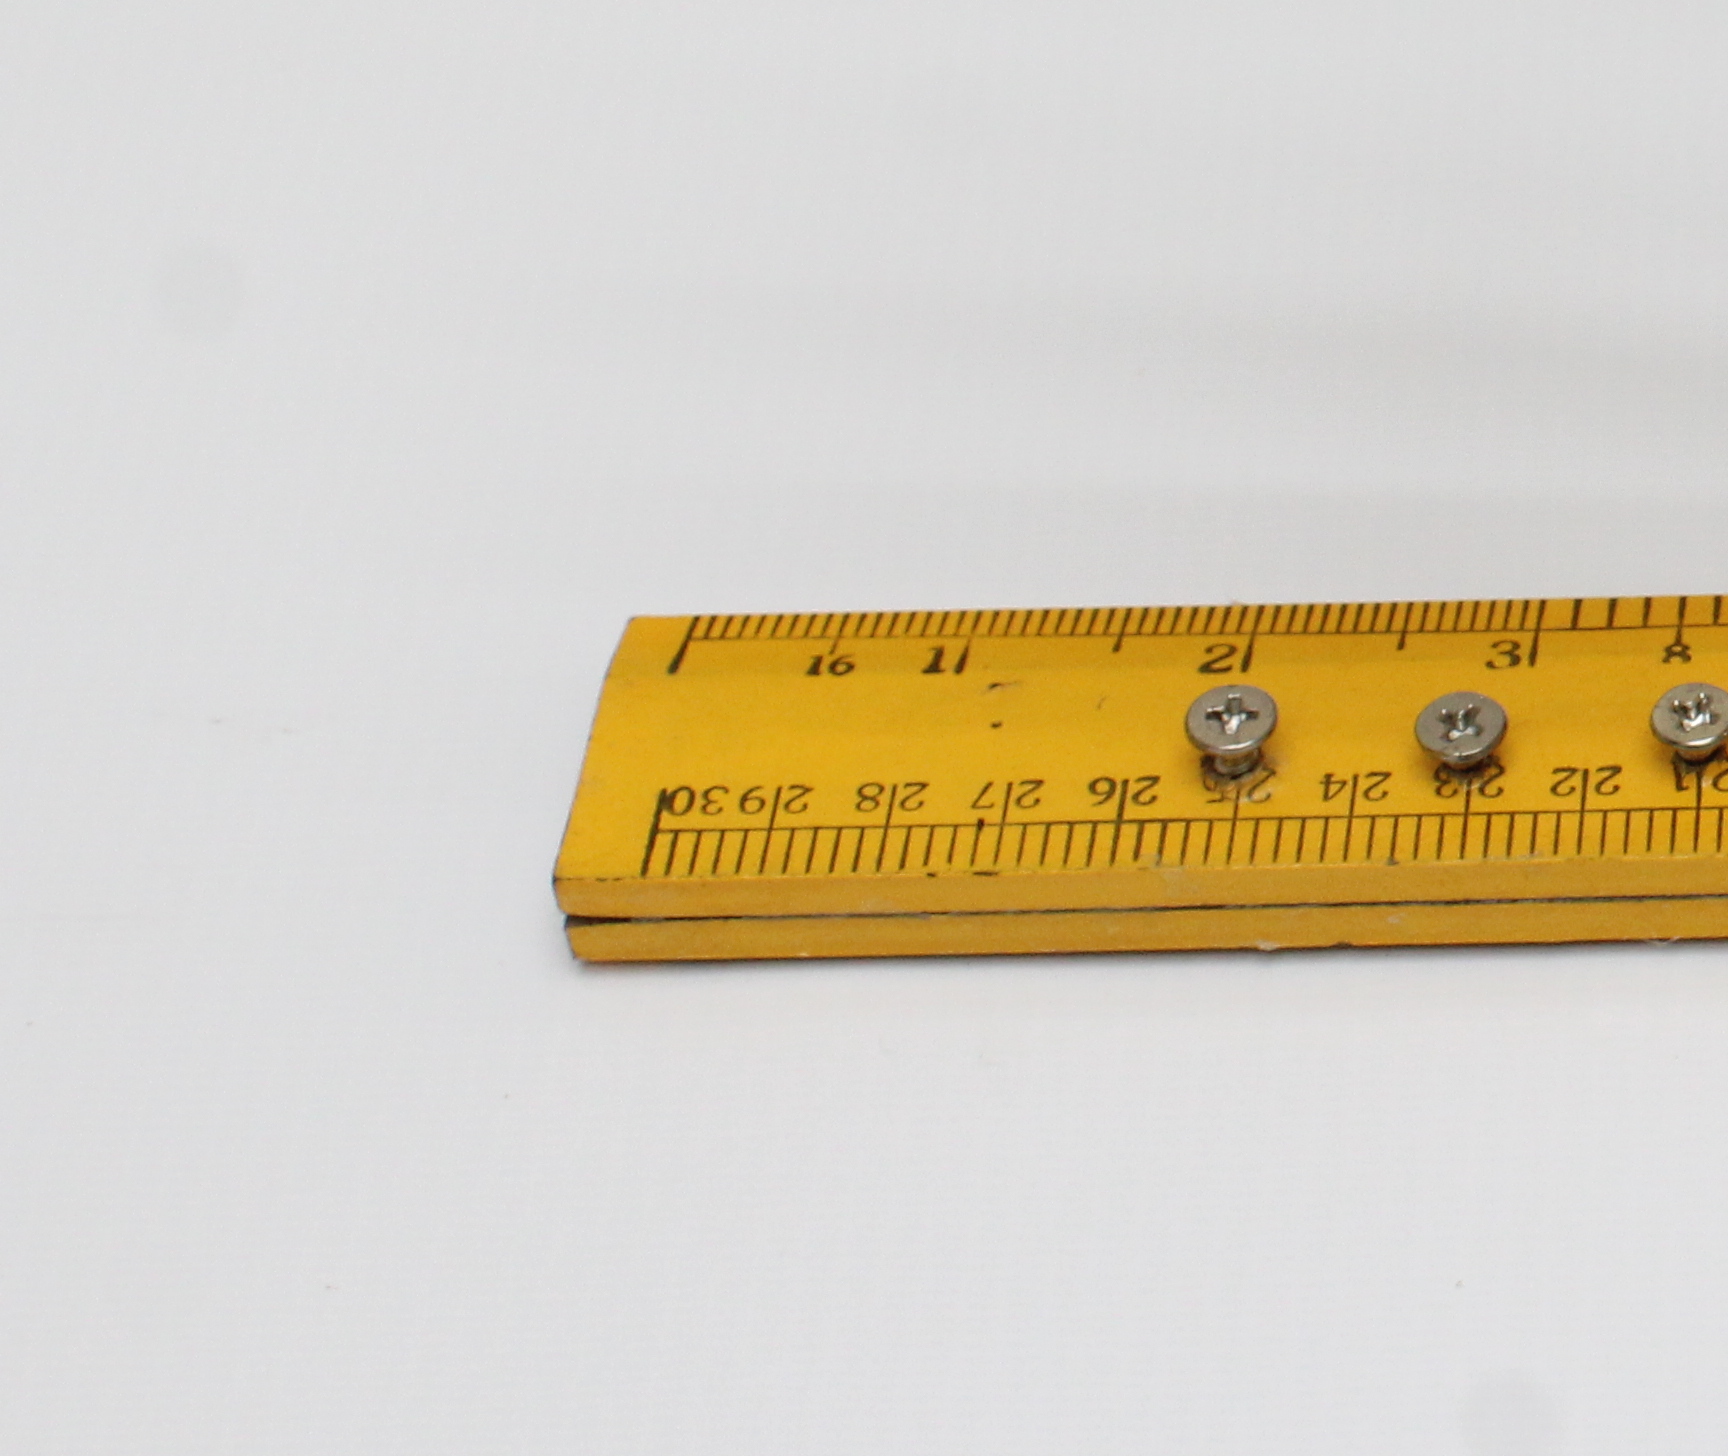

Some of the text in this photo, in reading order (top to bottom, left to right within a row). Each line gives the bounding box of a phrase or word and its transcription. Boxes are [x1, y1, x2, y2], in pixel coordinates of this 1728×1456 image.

[805, 654, 856, 677] 16
[921, 646, 947, 675] 1
[1198, 644, 1237, 673] 2
[1485, 641, 1522, 671] 3
[1661, 643, 1692, 665] 8
[855, 781, 929, 812] 28
[971, 778, 1044, 810] 27
[1320, 771, 1392, 802] 24
[1550, 764, 1623, 799] 22
[668, 785, 729, 817] 30
